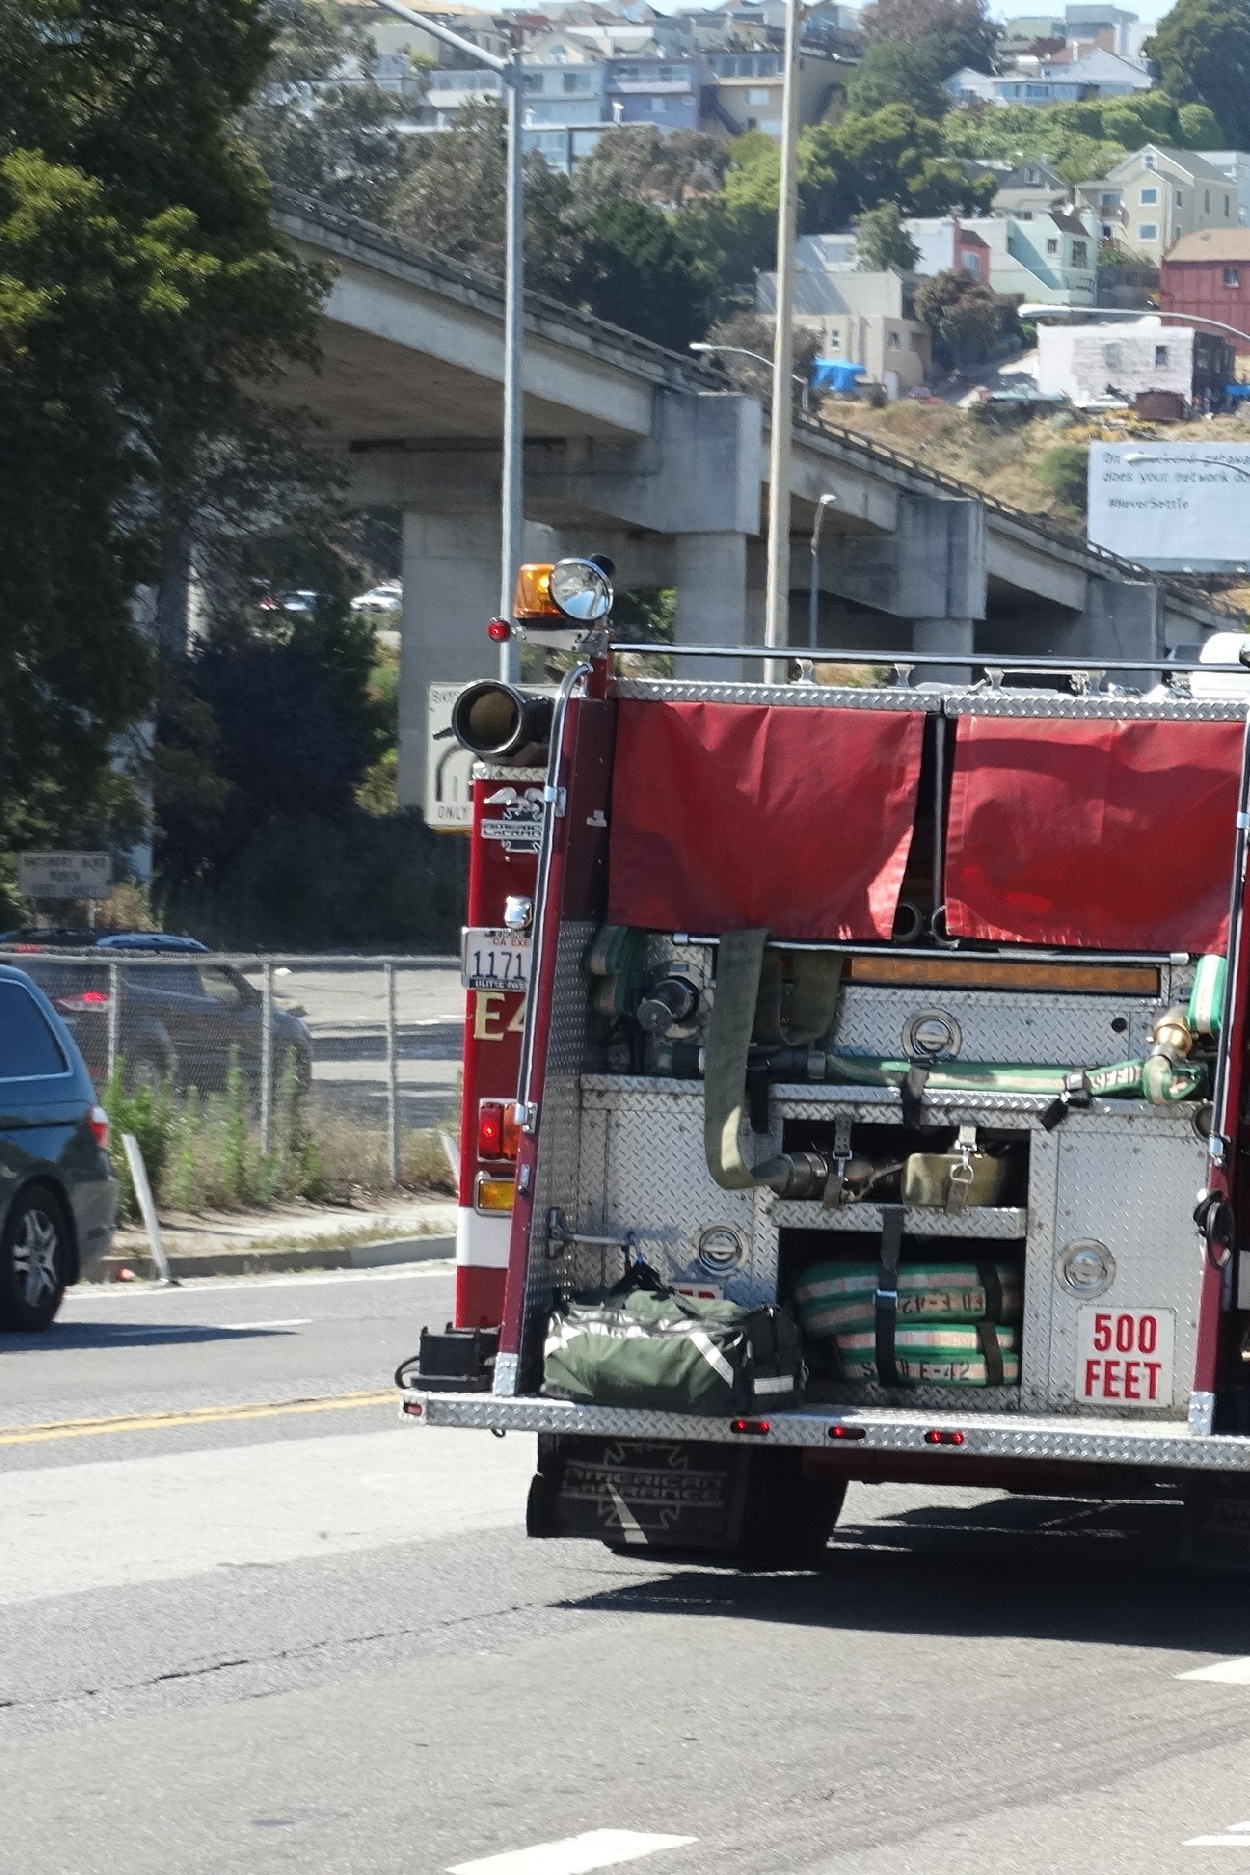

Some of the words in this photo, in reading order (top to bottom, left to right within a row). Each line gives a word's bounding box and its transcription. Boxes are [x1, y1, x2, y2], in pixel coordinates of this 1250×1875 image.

[1102, 452, 1120, 464] On
[1102, 470, 1133, 482] does
[1140, 472, 1167, 484] your
[1174, 470, 1229, 482] network
[1107, 497, 1189, 509] #NeverSettle
[438, 804, 468, 820] ONLY
[511, 938, 529, 948] EXE
[473, 950, 526, 979] 1171
[473, 991, 528, 1041] E4
[1094, 1313, 1157, 1353] 500
[1084, 1360, 1162, 1400] FEET
[563, 1466, 722, 1488] AMERICAN
